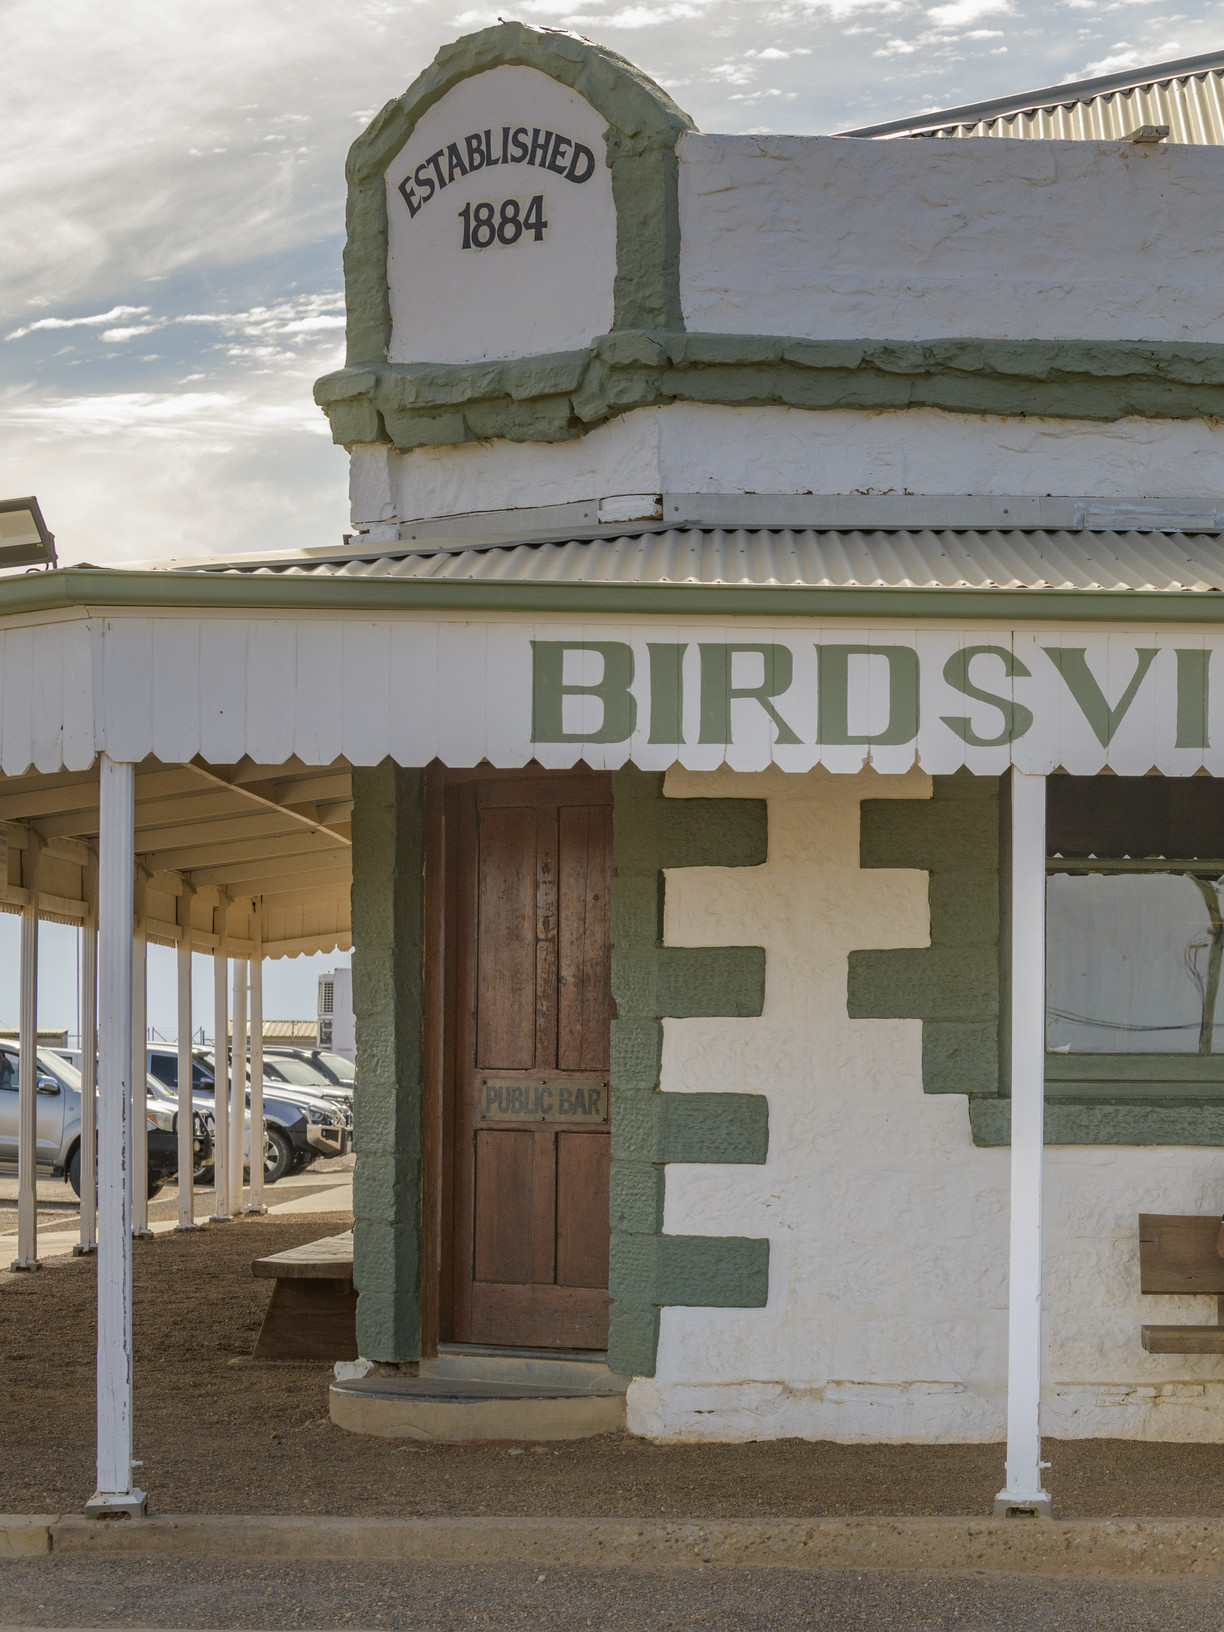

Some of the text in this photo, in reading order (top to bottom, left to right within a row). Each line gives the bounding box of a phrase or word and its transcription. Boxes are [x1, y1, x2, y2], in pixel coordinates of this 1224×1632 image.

[398, 127, 595, 219] ESTABLISHED
[458, 195, 547, 249] 1884
[486, 1086, 601, 1115] PUBLIC BAR
